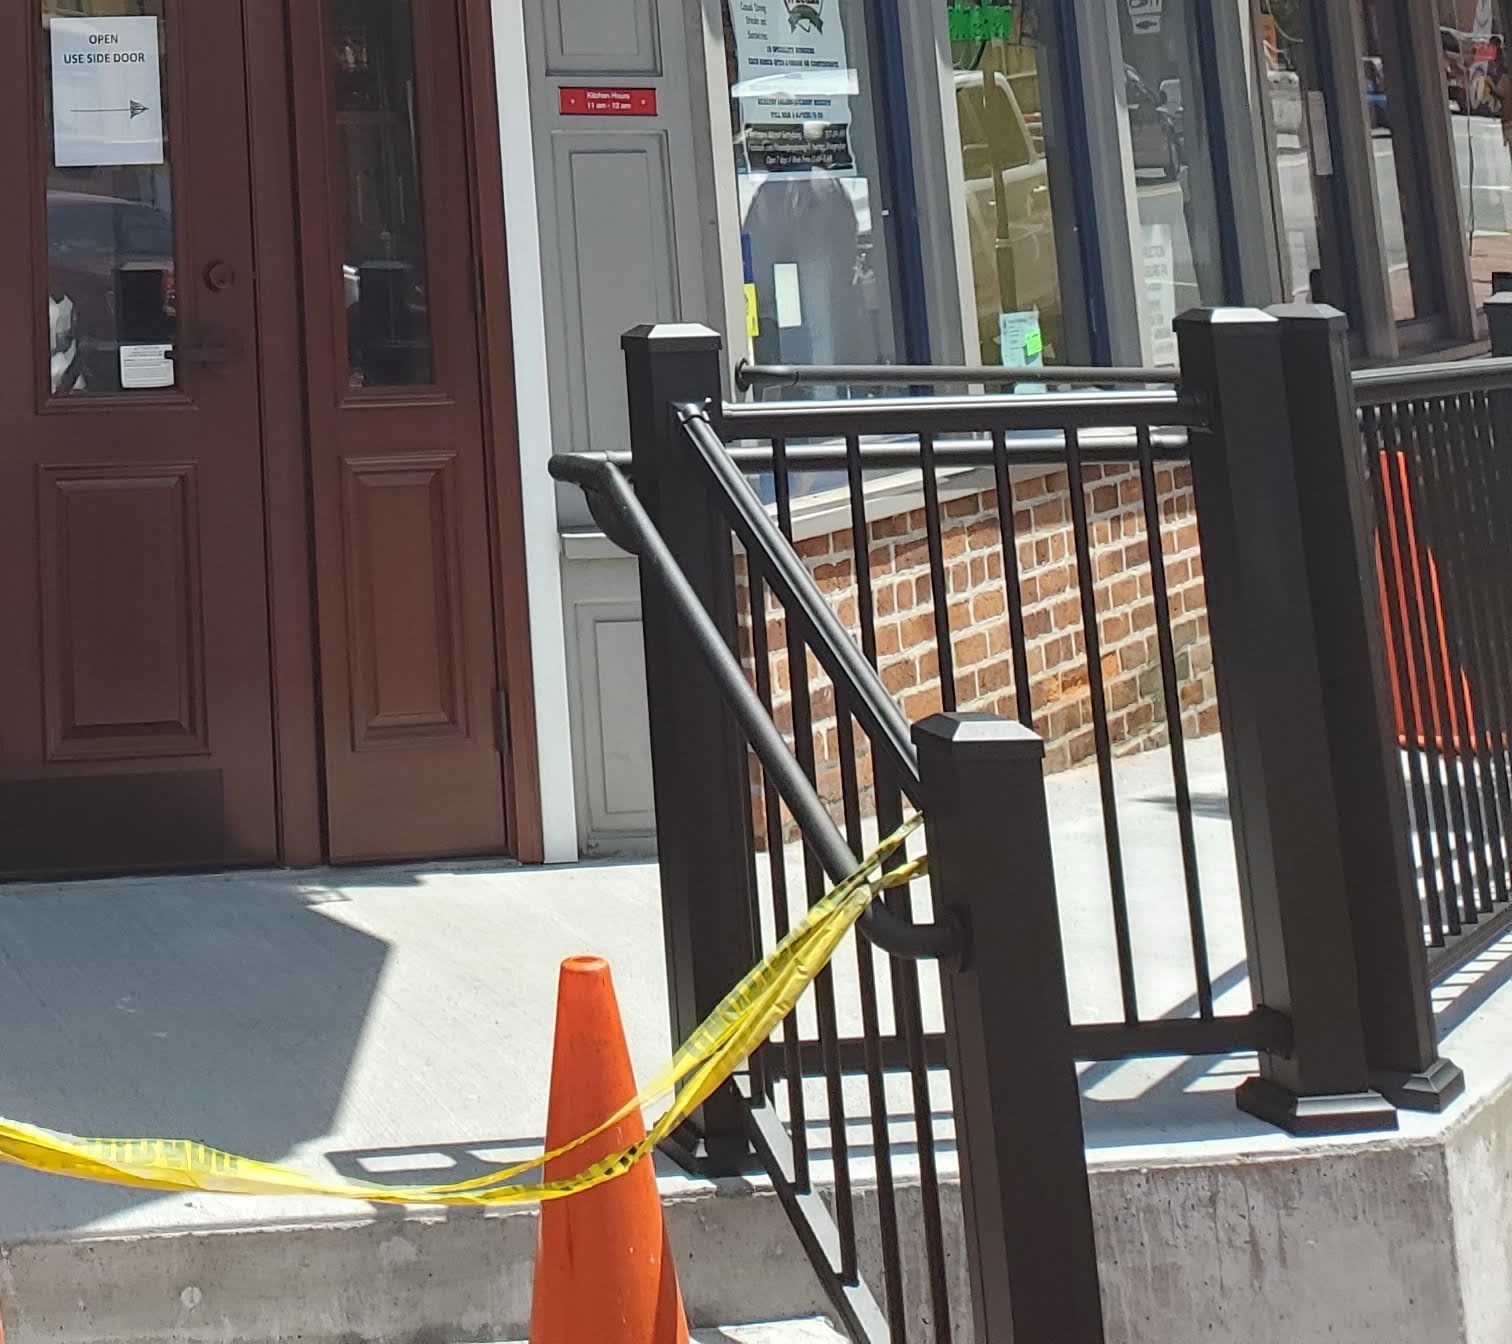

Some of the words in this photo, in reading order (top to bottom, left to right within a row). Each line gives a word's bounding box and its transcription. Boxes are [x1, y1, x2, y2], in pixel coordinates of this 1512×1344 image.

[89, 34, 118, 44] OPEN
[64, 54, 85, 64] USE
[86, 53, 110, 64] SIDE
[113, 53, 145, 63] DOOR
